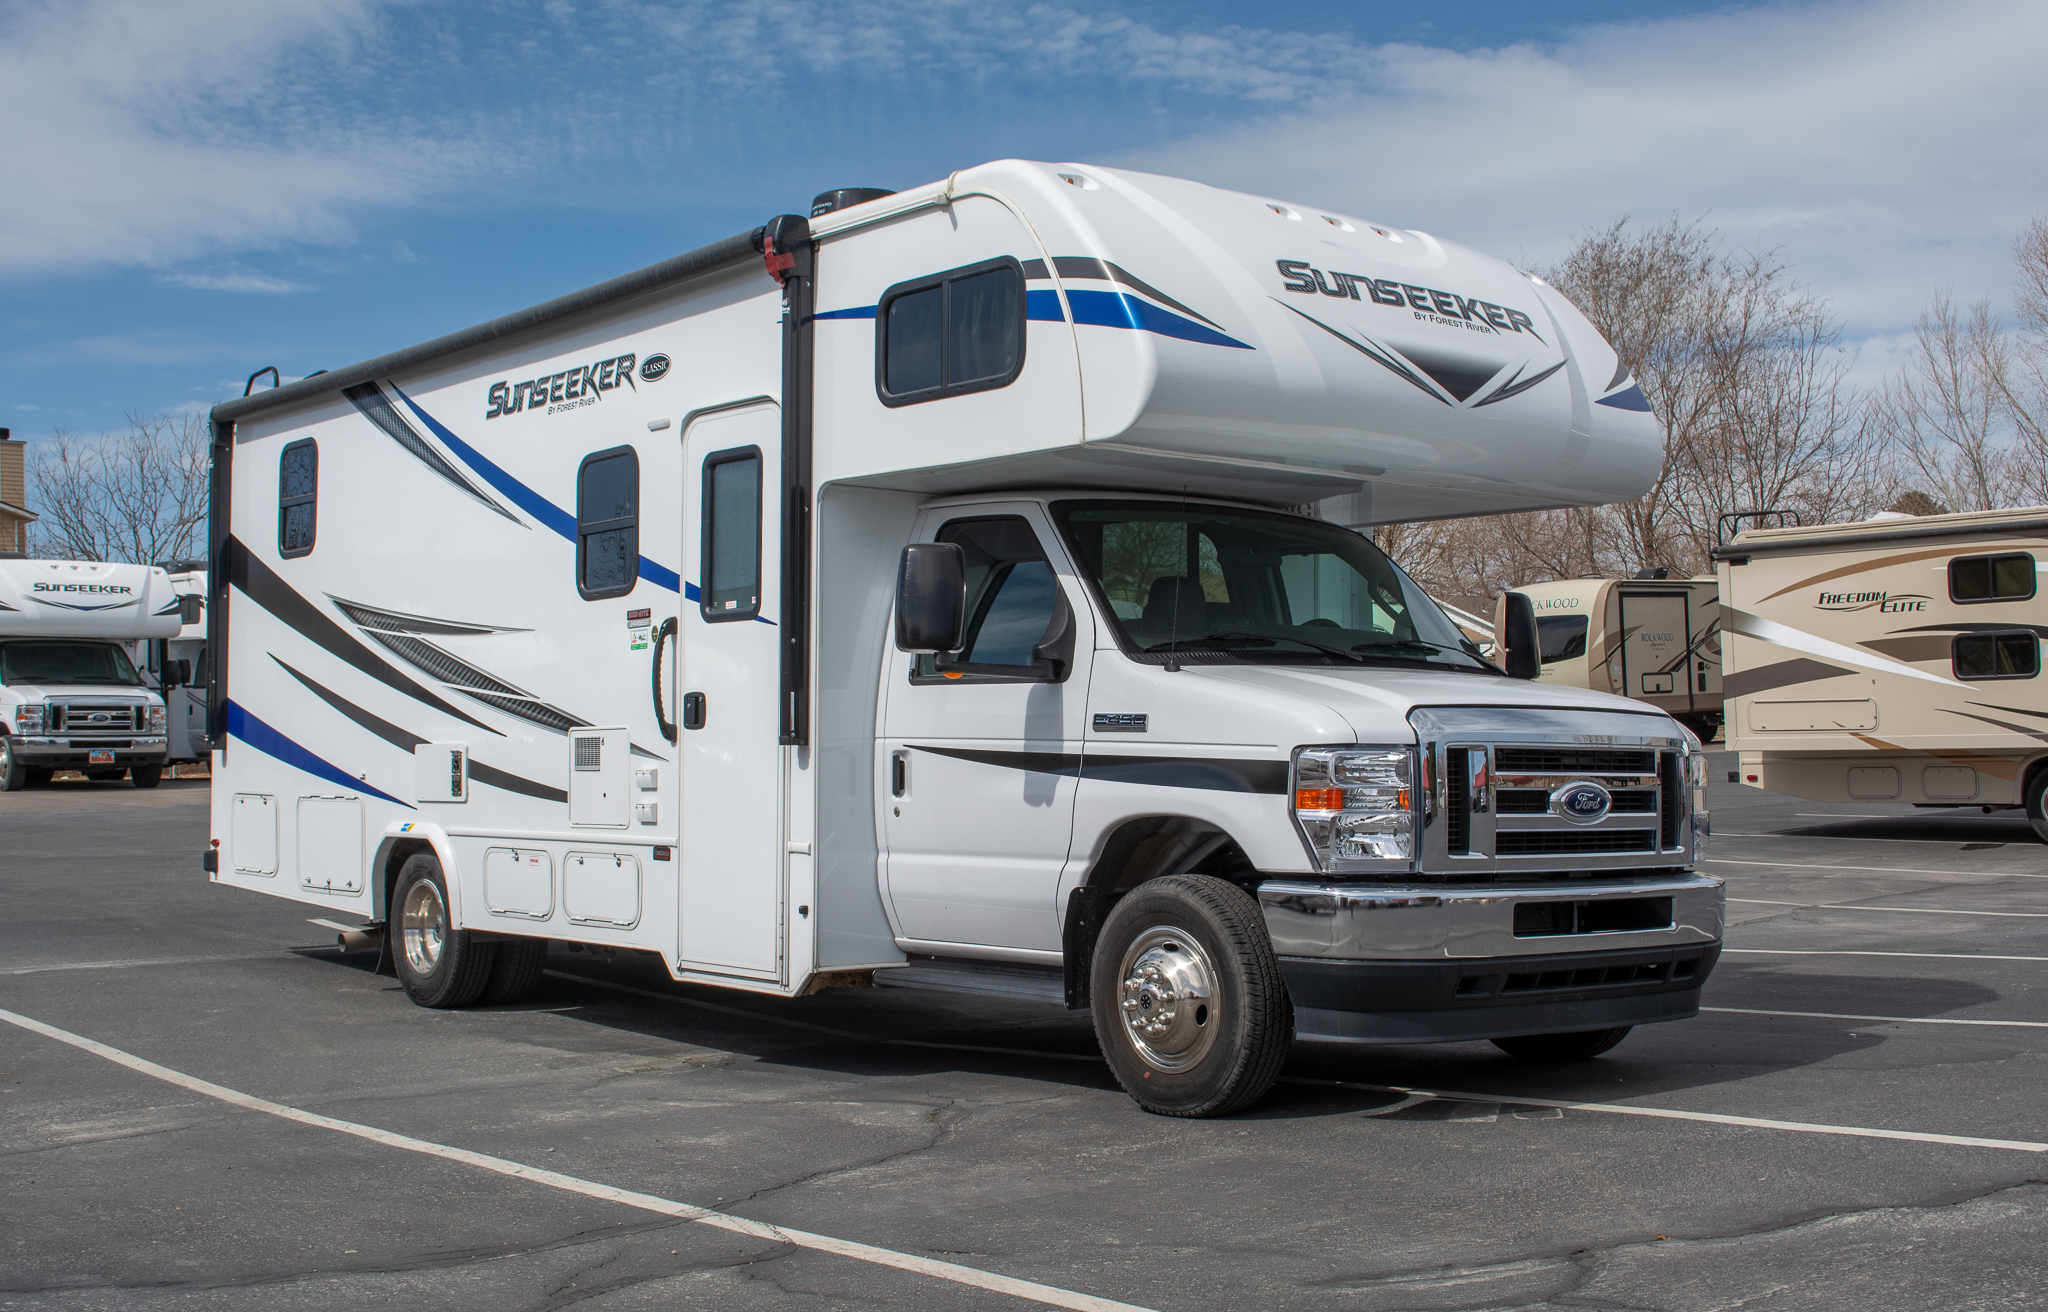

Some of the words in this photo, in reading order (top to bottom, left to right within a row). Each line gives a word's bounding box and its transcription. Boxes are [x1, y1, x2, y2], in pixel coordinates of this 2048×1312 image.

[642, 360, 670, 375] CLASSIC
[1818, 591, 1887, 605] FREEDOM
[1879, 600, 1927, 613] ELITE
[1641, 633, 1675, 642] ROCKWOOD
[1575, 792, 1601, 810] Ford
